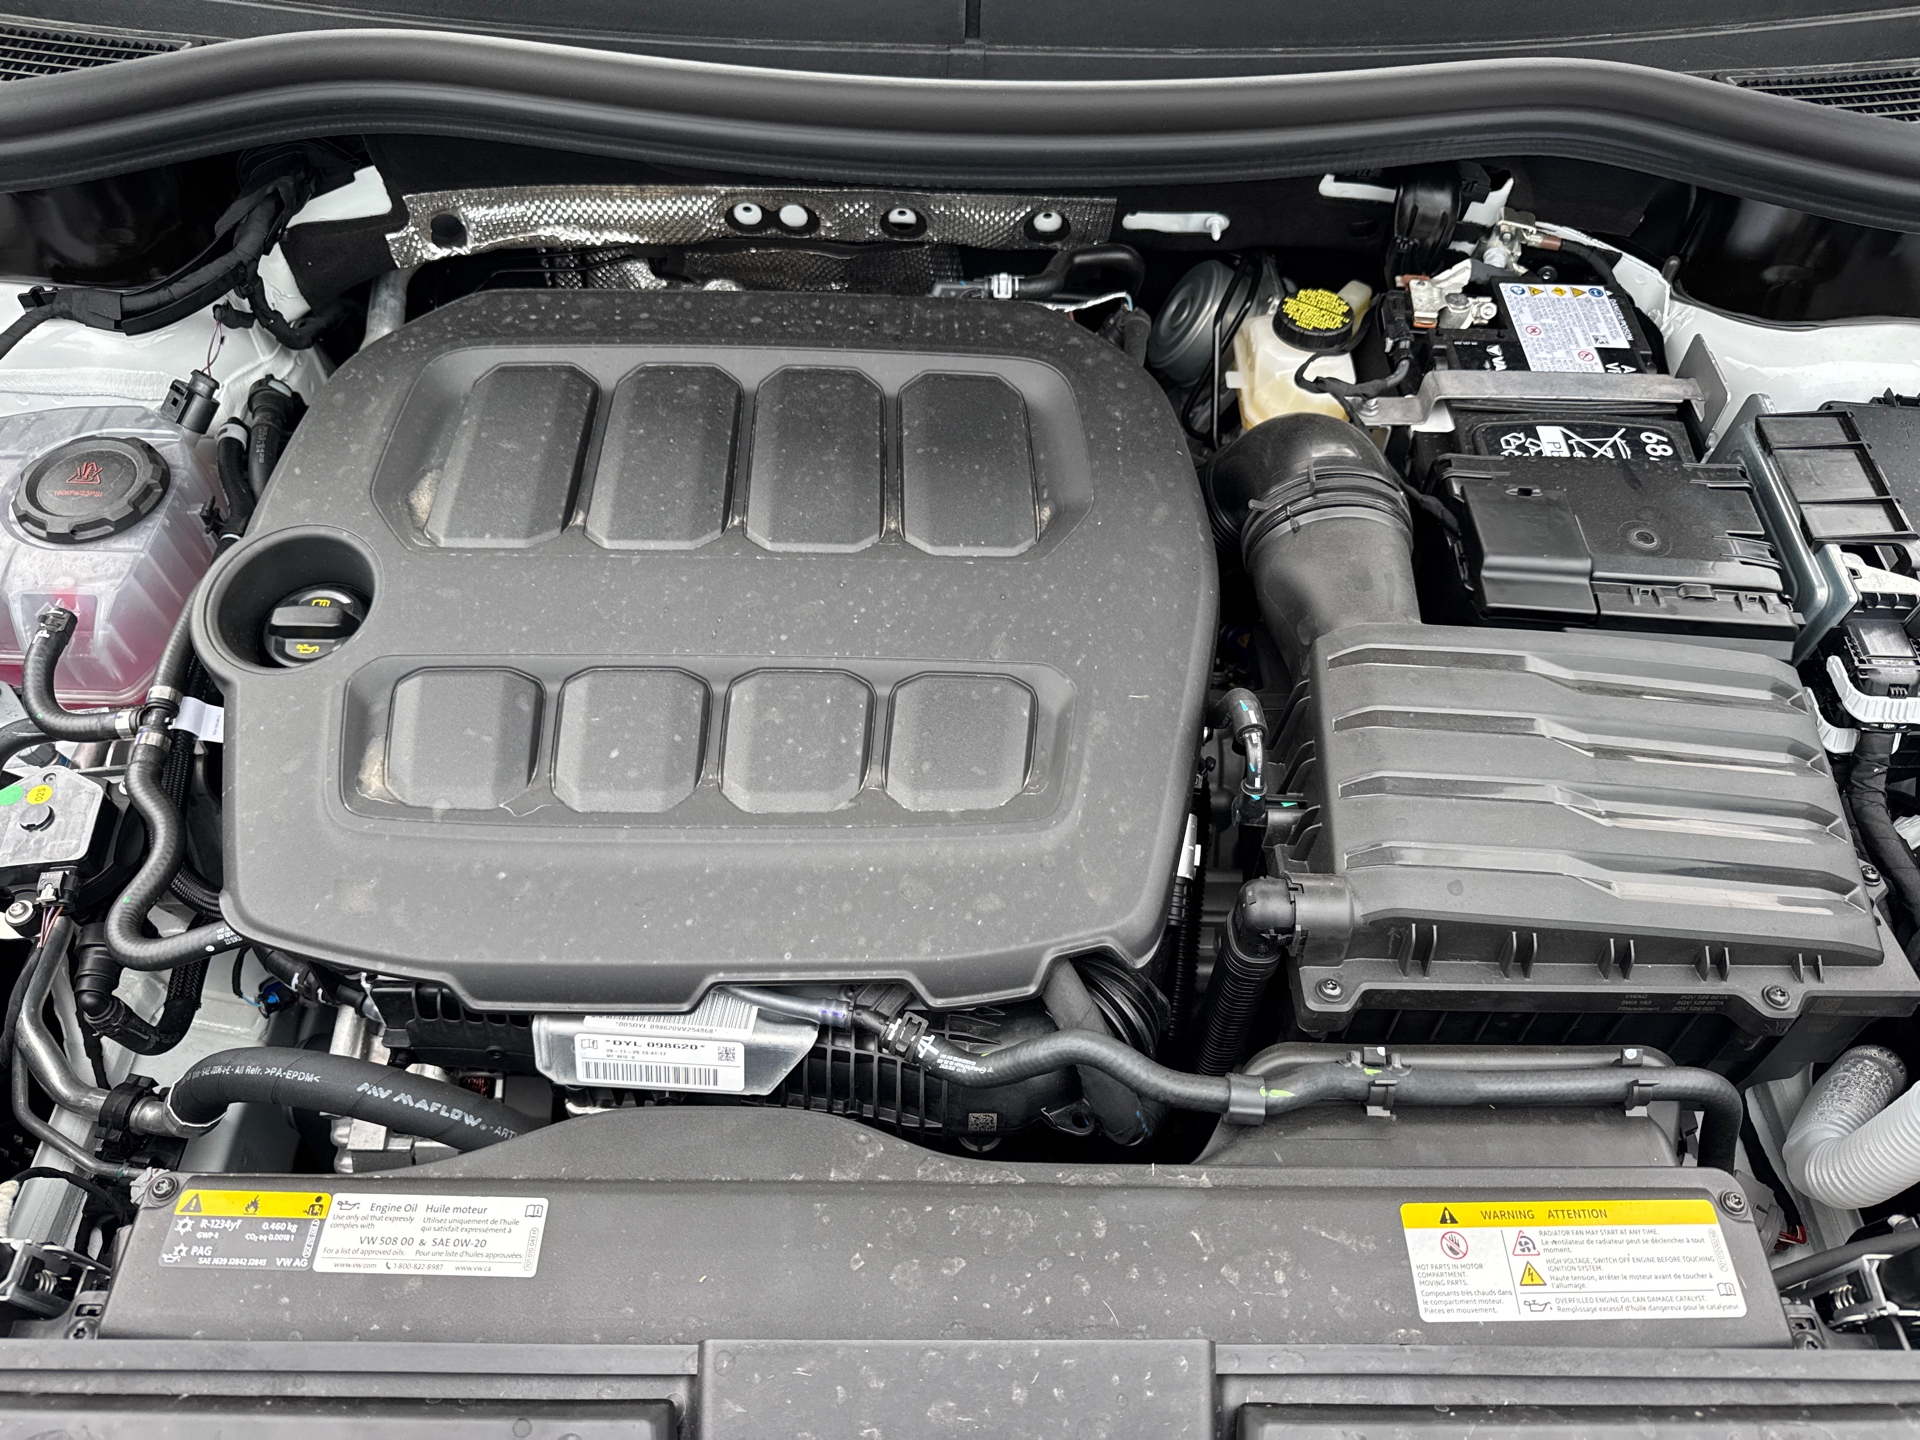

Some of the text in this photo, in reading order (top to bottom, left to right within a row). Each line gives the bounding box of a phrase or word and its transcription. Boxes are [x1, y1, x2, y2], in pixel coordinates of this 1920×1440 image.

[234, 1066, 244, 1074] All
[245, 1066, 262, 1076] Refr.
[370, 1203, 488, 1214] Engine Oil Huile moteur
[346, 1214, 360, 1222] only
[384, 1215, 414, 1224] expressly
[1480, 1208, 1608, 1220] WARNING ATTENTION
[200, 1219, 298, 1233] R-1234yf 0.460 kg
[330, 1222, 375, 1230] complies with
[423, 1216, 448, 1224] Utilisez
[448, 1218, 489, 1226] uniquement
[499, 1218, 520, 1226] l'huile
[460, 1226, 506, 1234] expressément
[507, 1226, 512, 1234] à
[360, 1236, 487, 1248] VW 508 00 & SAE 0W-20
[1626, 1238, 1641, 1246] peut
[190, 1246, 212, 1256] PAG
[360, 1248, 392, 1257] approved
[445, 1250, 458, 1258] liste
[460, 1250, 484, 1258] d'huiles
[198, 1257, 308, 1268] SAE J639 J2842 J2845 VW AG
[1632, 1256, 1655, 1264] ENGINE
[334, 1262, 377, 1270] www.vw.com
[393, 1262, 444, 1271] 1-800-822-8987
[1570, 1274, 1598, 1282] tension,
[1682, 1272, 1708, 1280] toucher
[1421, 1290, 1460, 1298] Composants
[1429, 1299, 1477, 1307] compartiment
[1556, 1305, 1598, 1314] Remplissage
[1648, 1304, 1682, 1313] dangereux
[1706, 1303, 1741, 1312] catalyseur.
